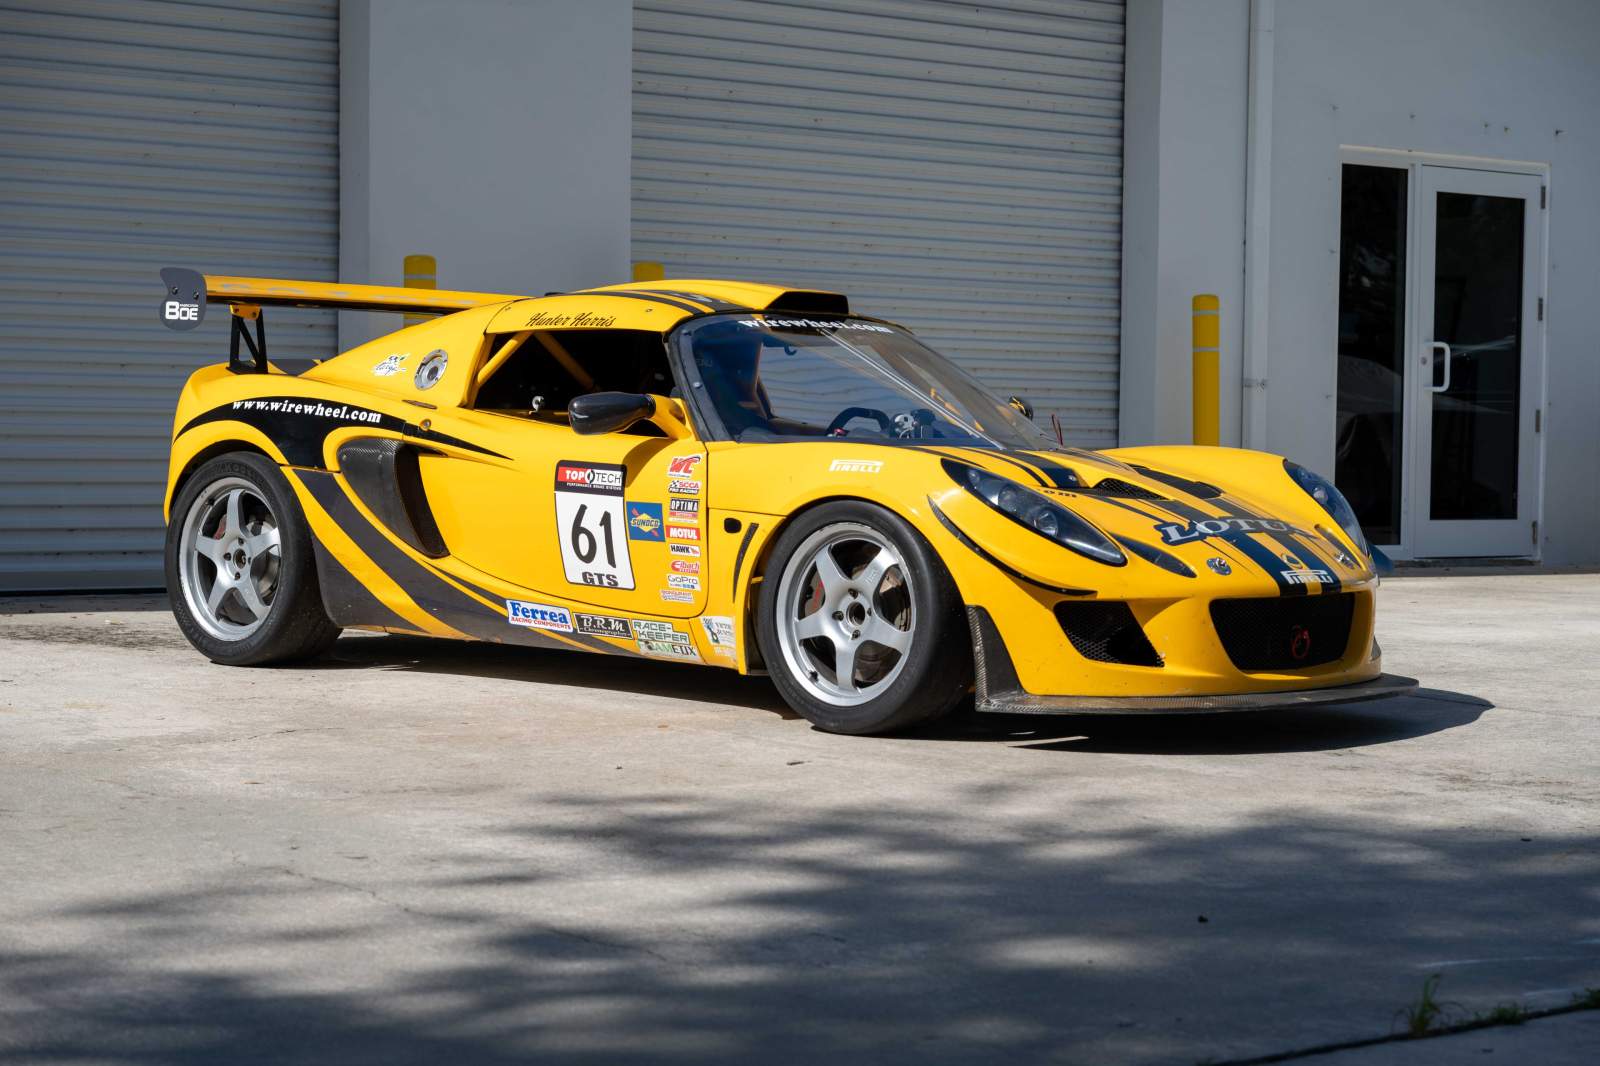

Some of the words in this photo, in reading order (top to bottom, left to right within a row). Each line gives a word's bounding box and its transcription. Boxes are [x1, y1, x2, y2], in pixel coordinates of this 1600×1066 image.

[525, 312, 570, 327] Hunter
[569, 312, 617, 327] Harris
[738, 318, 894, 334] wirewheel.com
[232, 399, 382, 423] www.wirewheel.com
[829, 459, 884, 473] PIRELLI
[679, 481, 699, 489] SCCA
[671, 500, 698, 511] OPTIMA
[630, 518, 660, 529] SUNOCO
[571, 503, 617, 569] 61
[669, 528, 698, 540] MOTUL
[671, 545, 691, 554] HAWK
[581, 571, 619, 587] GTS
[667, 574, 698, 585] GoPro
[1280, 569, 1334, 585] PIRELLI
[509, 601, 569, 624] Ferrea
[511, 616, 532, 624] RACING
[533, 619, 572, 630] COMPONENTS
[633, 621, 672, 633] RACE-
[638, 630, 688, 643] KEEPER
